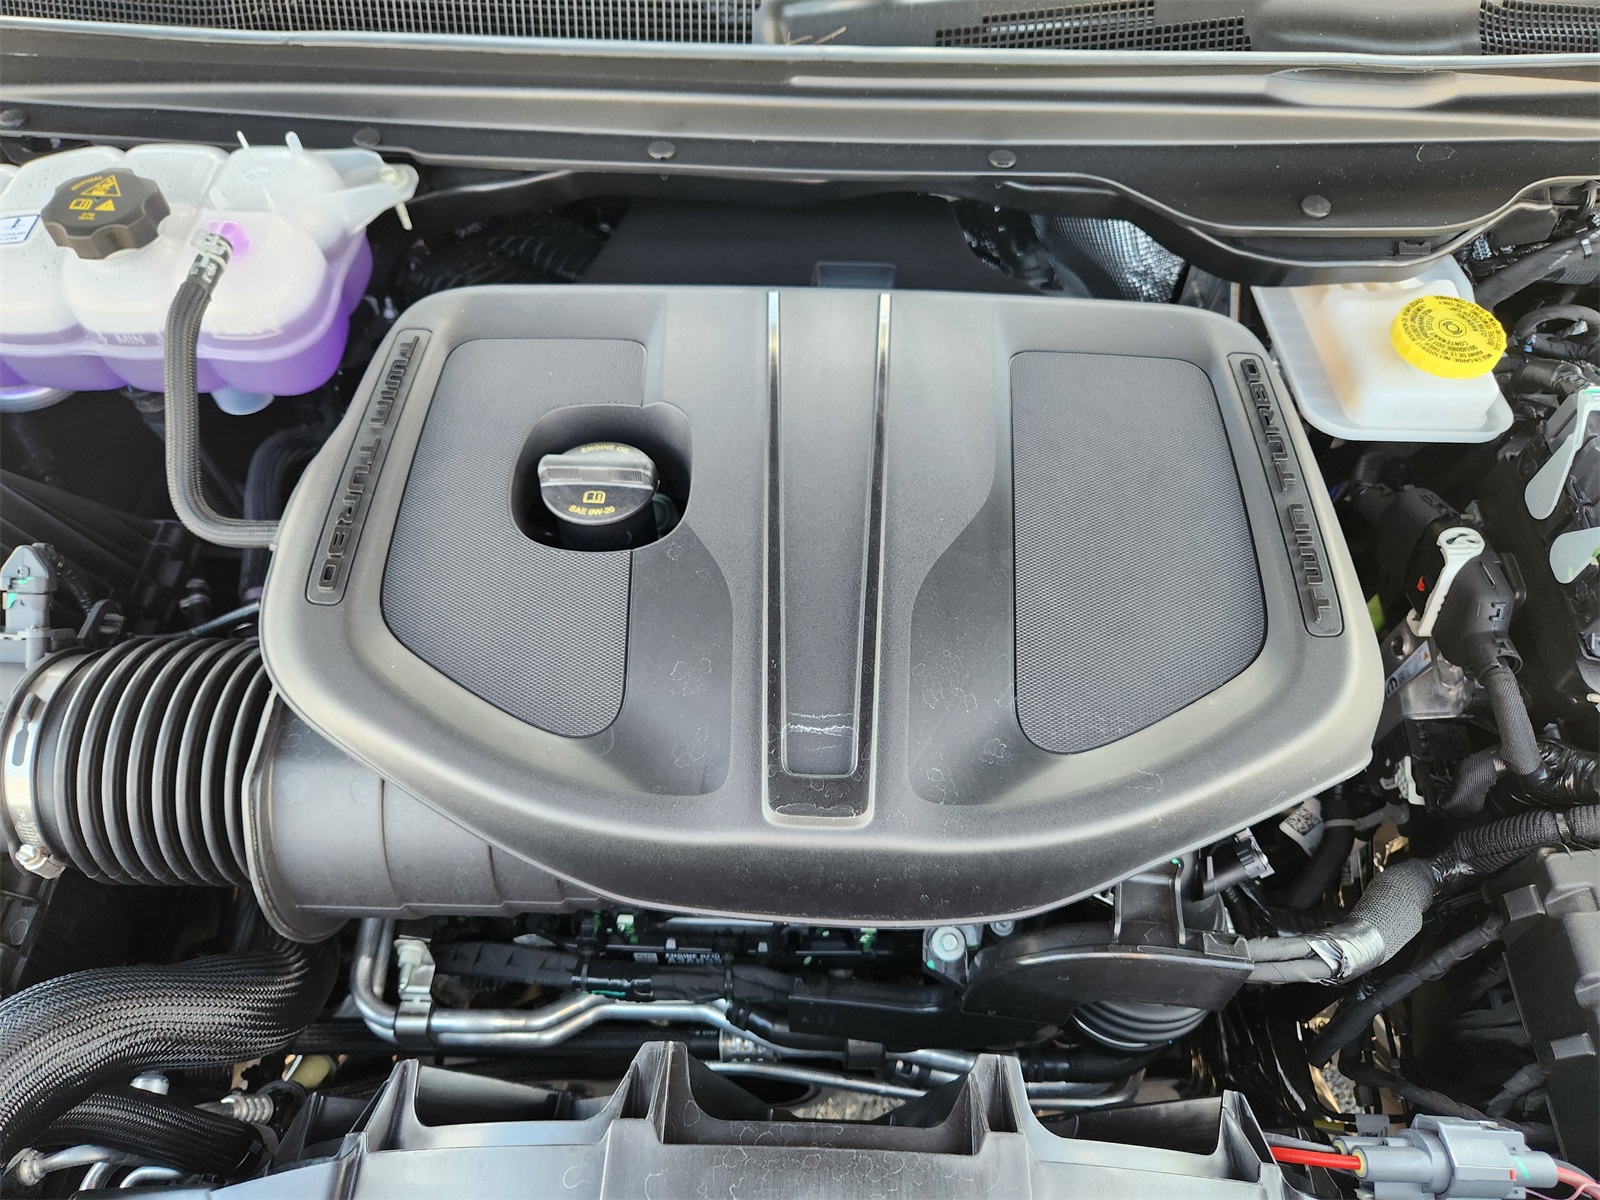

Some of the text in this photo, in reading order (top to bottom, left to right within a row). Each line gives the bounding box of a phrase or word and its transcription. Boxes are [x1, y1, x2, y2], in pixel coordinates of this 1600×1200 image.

[115, 335, 146, 345] MIN
[1430, 332, 1469, 346] CONTENANT
[1433, 341, 1445, 349] DOT
[581, 444, 629, 454] ENGINE OIL
[317, 335, 419, 592] TWIN TURBO
[1240, 358, 1331, 623] TWIN TURBO
[568, 505, 616, 515] SAE 0W-20
